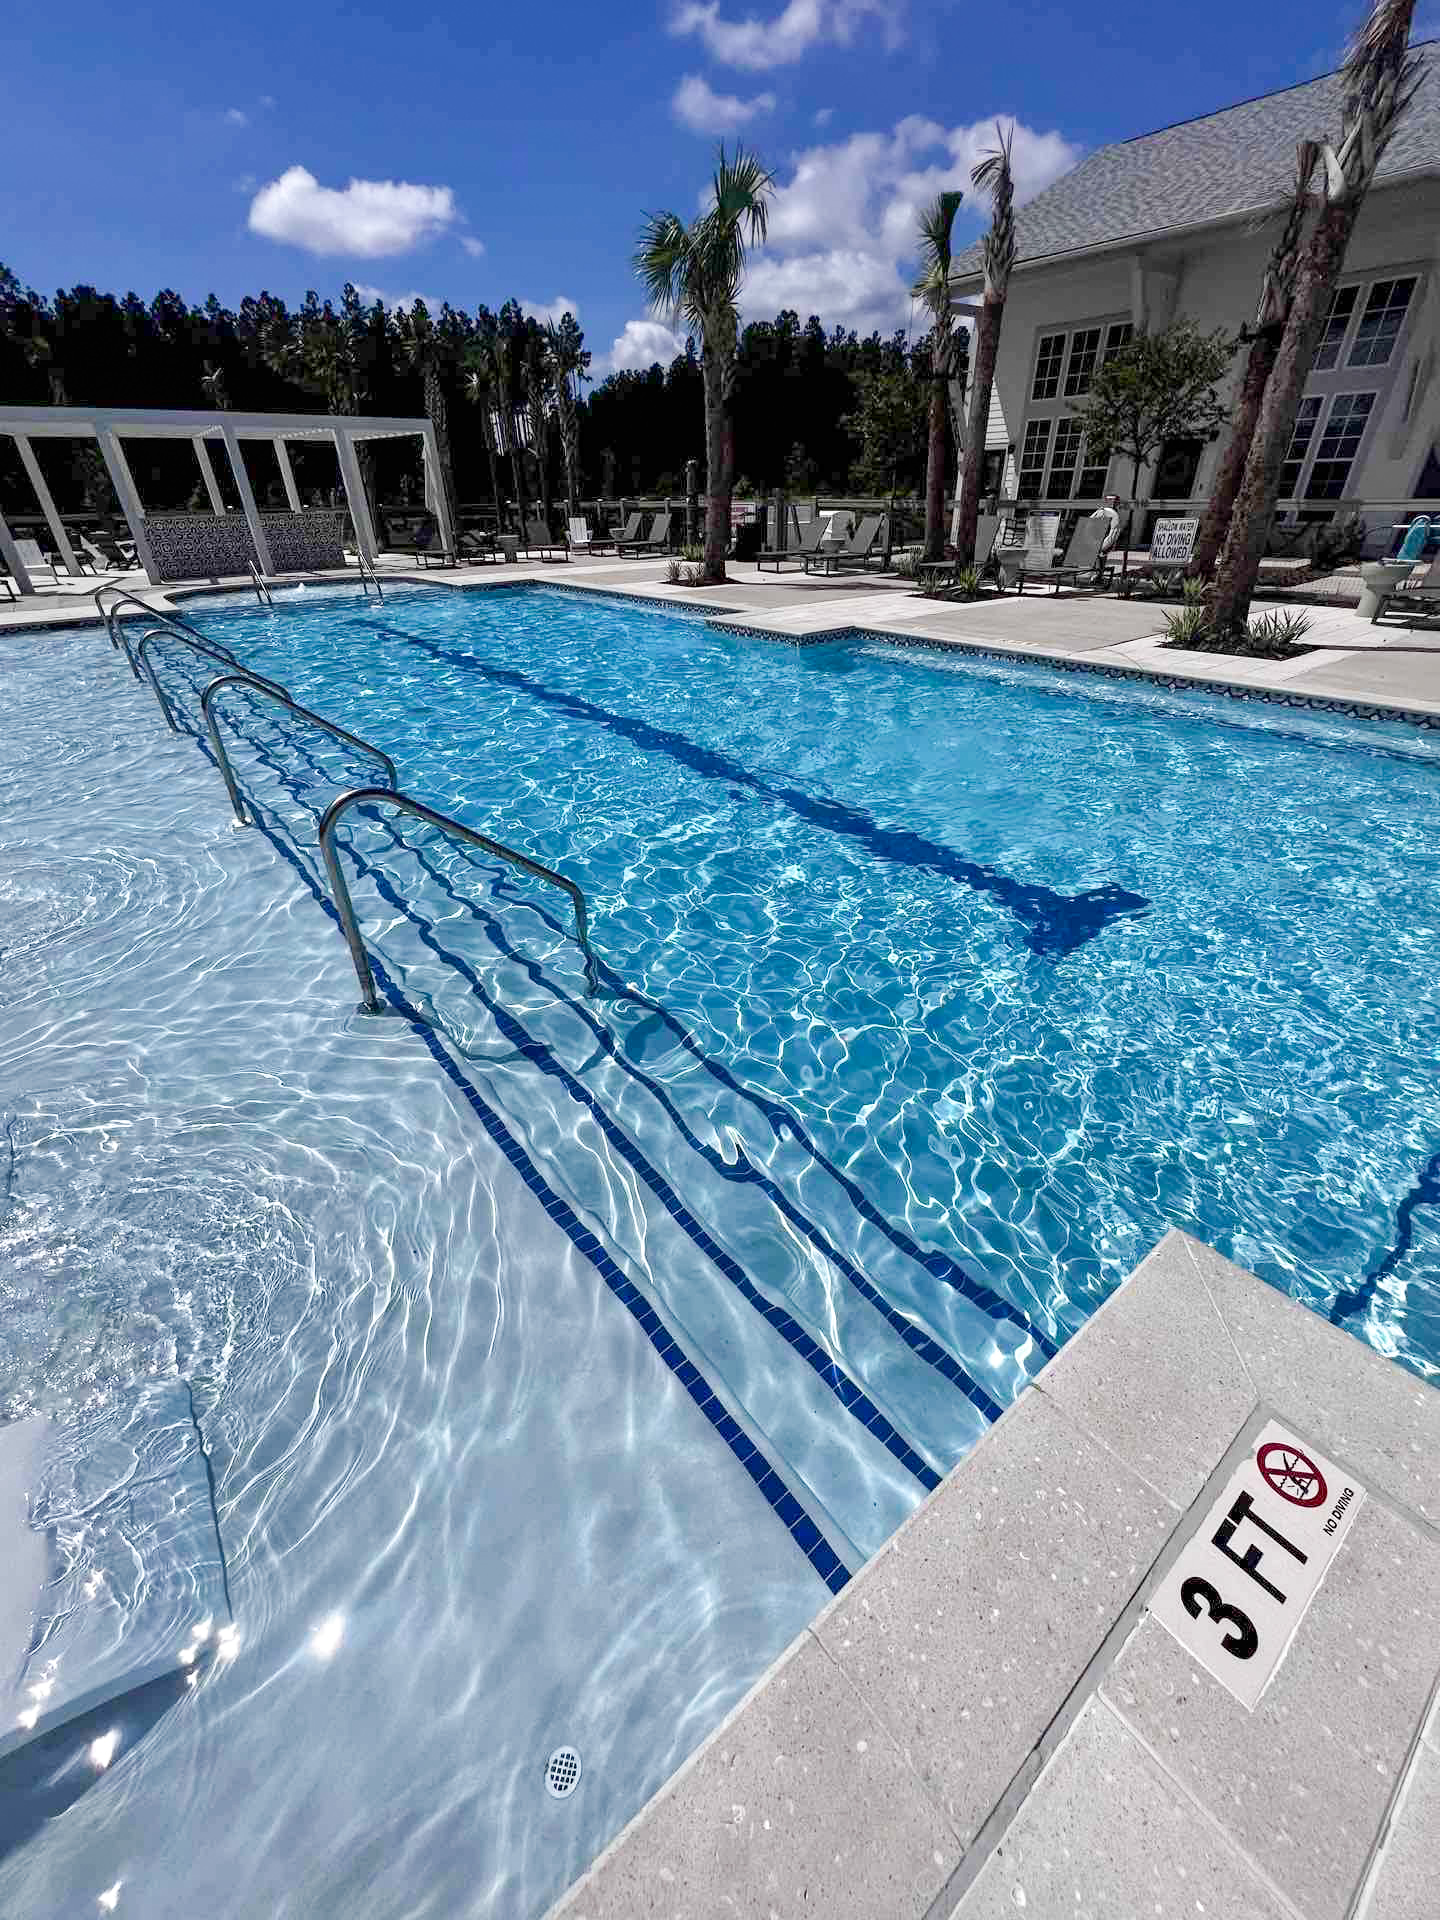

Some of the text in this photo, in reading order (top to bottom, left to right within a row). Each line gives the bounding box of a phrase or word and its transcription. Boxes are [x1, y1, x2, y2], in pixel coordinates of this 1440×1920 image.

[1153, 533, 1192, 546] NO DIVING
[1153, 546, 1188, 559] ALLOWED
[1323, 1487, 1354, 1537] NO DIVING
[1180, 1489, 1308, 1660] 3 FT
